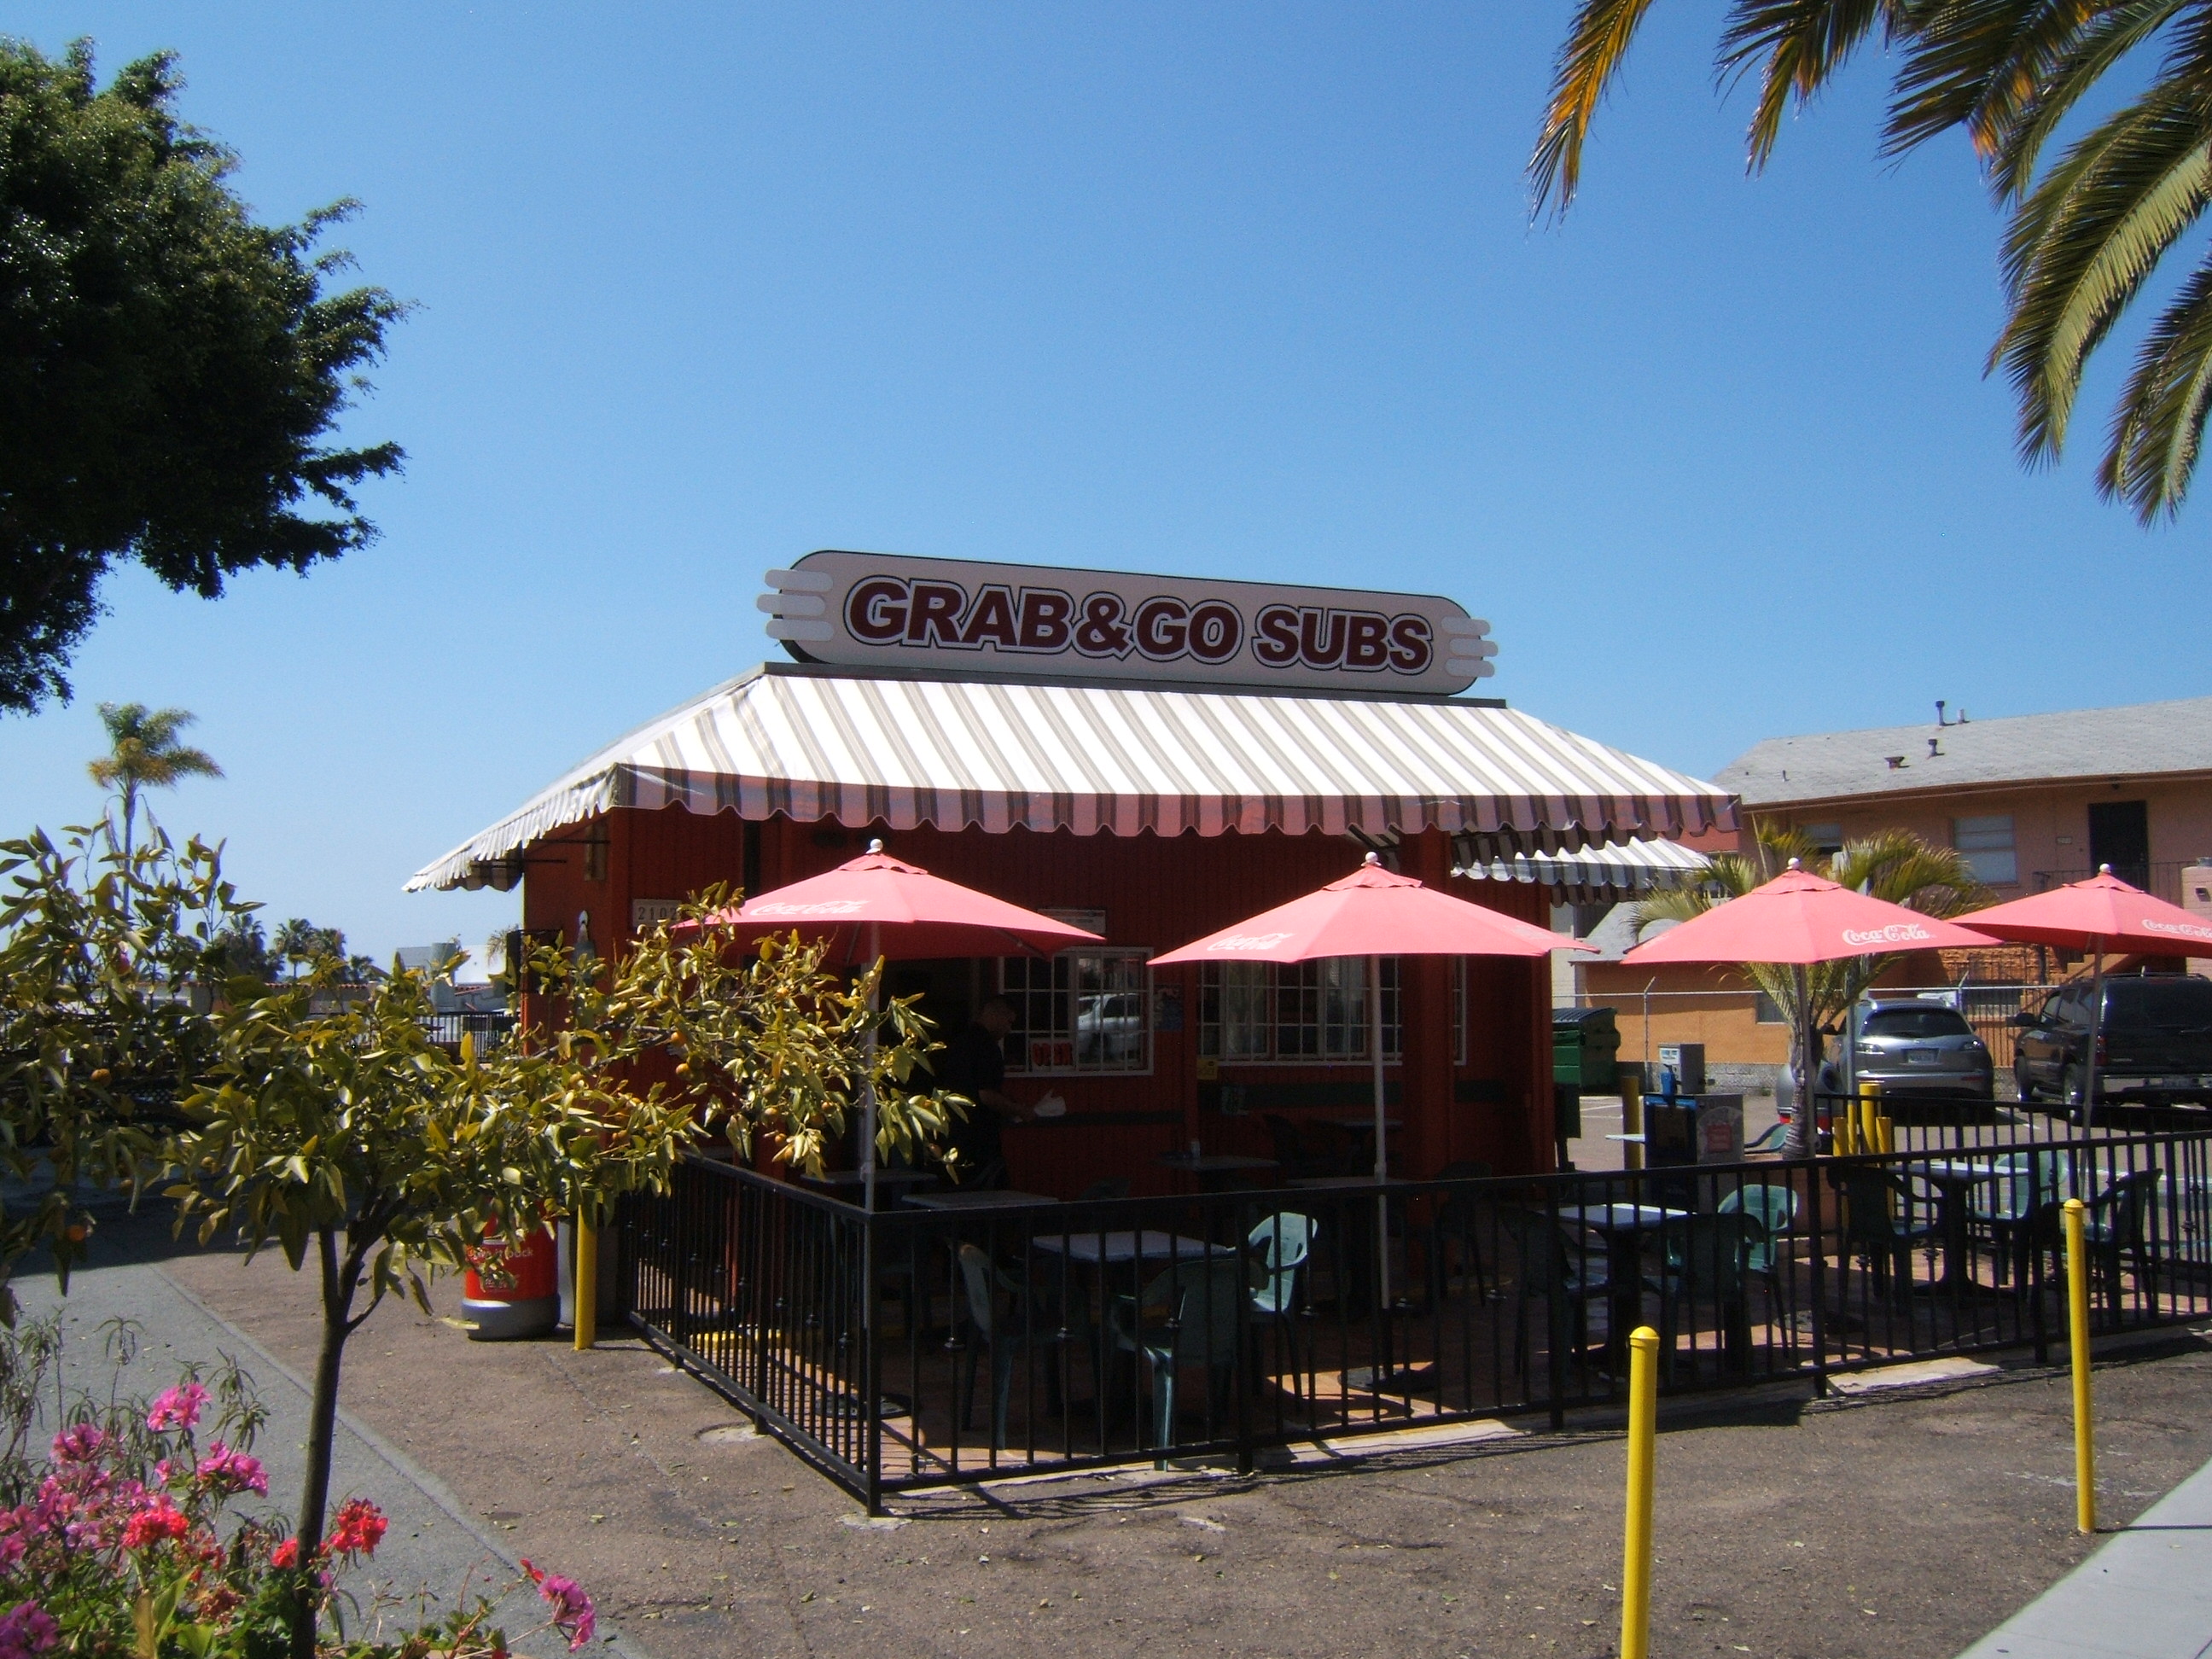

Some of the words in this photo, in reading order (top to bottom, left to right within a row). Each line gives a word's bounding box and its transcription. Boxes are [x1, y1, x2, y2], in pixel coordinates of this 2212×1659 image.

[848, 581, 1239, 660] GRAB&GO
[1256, 609, 1430, 671] SUBS
[638, 906, 677, 920] 2102
[1842, 923, 1930, 946] Coca-Cola
